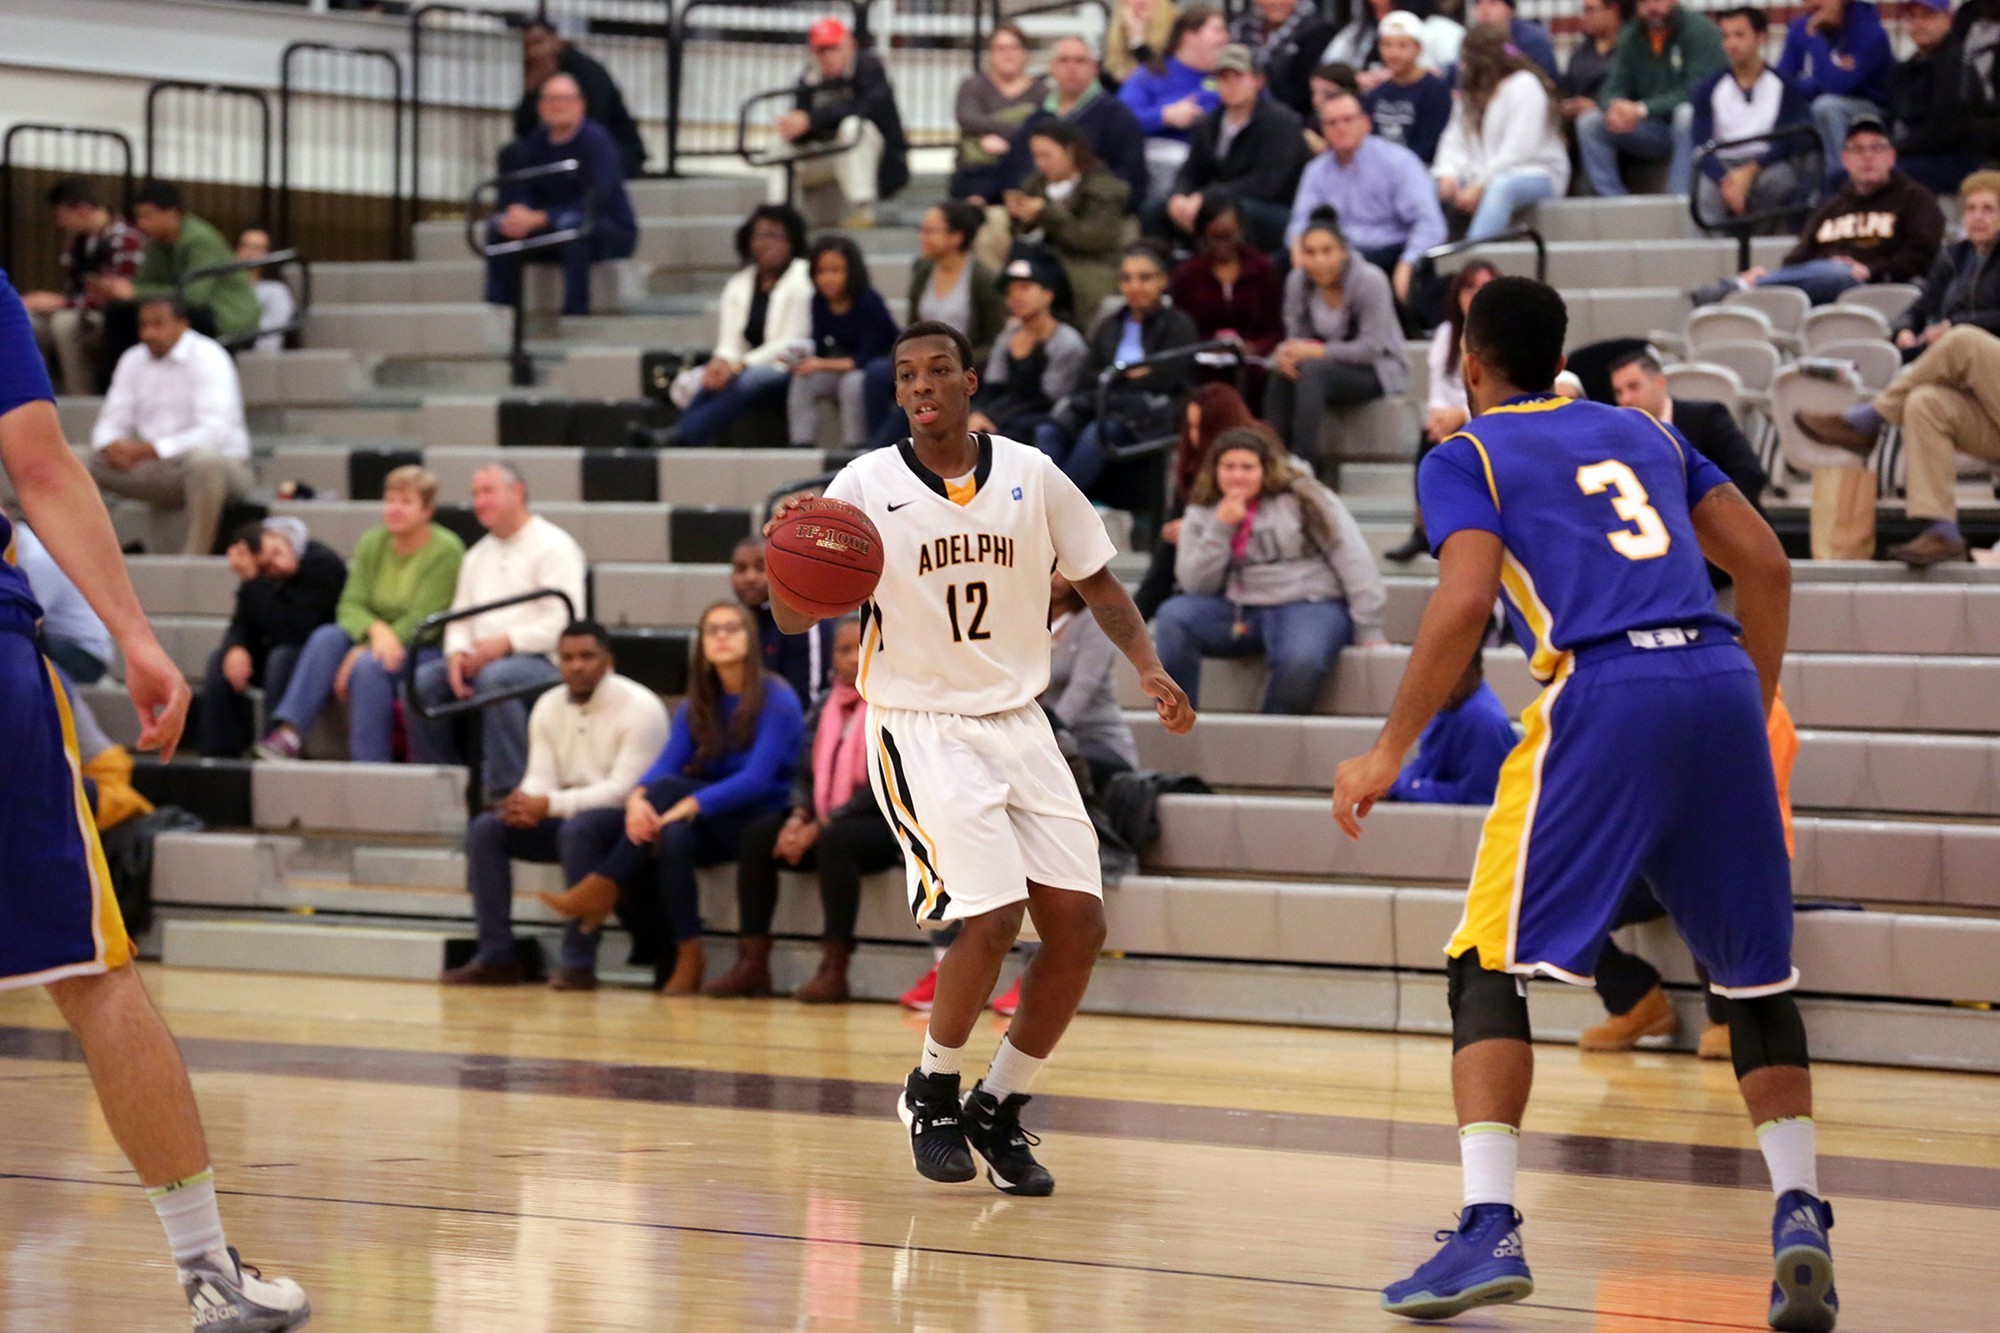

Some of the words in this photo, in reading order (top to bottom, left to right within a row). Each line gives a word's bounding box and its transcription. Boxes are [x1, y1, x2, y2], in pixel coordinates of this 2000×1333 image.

[1576, 460, 1671, 560] 3
[918, 533, 1014, 576] ADELPHI
[946, 581, 991, 642] 12
